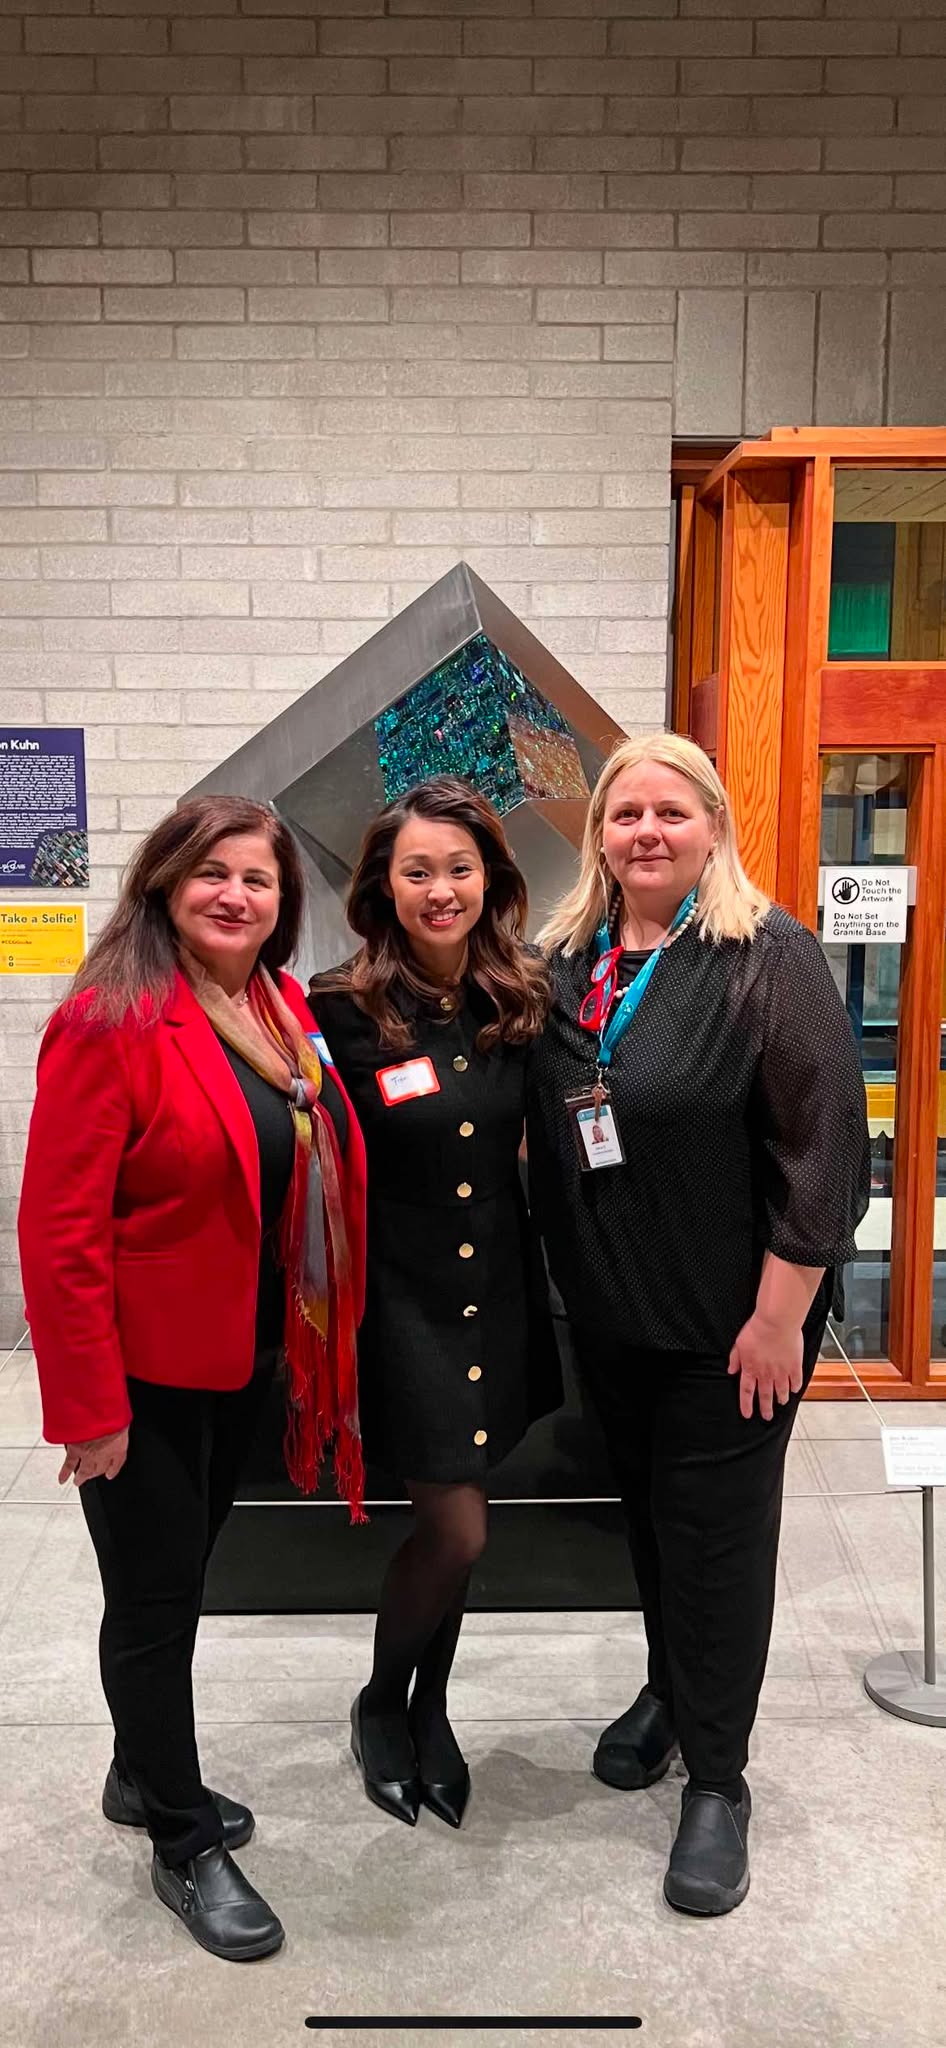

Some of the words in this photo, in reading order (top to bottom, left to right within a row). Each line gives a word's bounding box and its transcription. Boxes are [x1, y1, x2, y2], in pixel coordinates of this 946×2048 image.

[10, 740, 39, 750] Kuhn
[1, 913, 28, 923] Take
[42, 913, 77, 923] Selfie!
